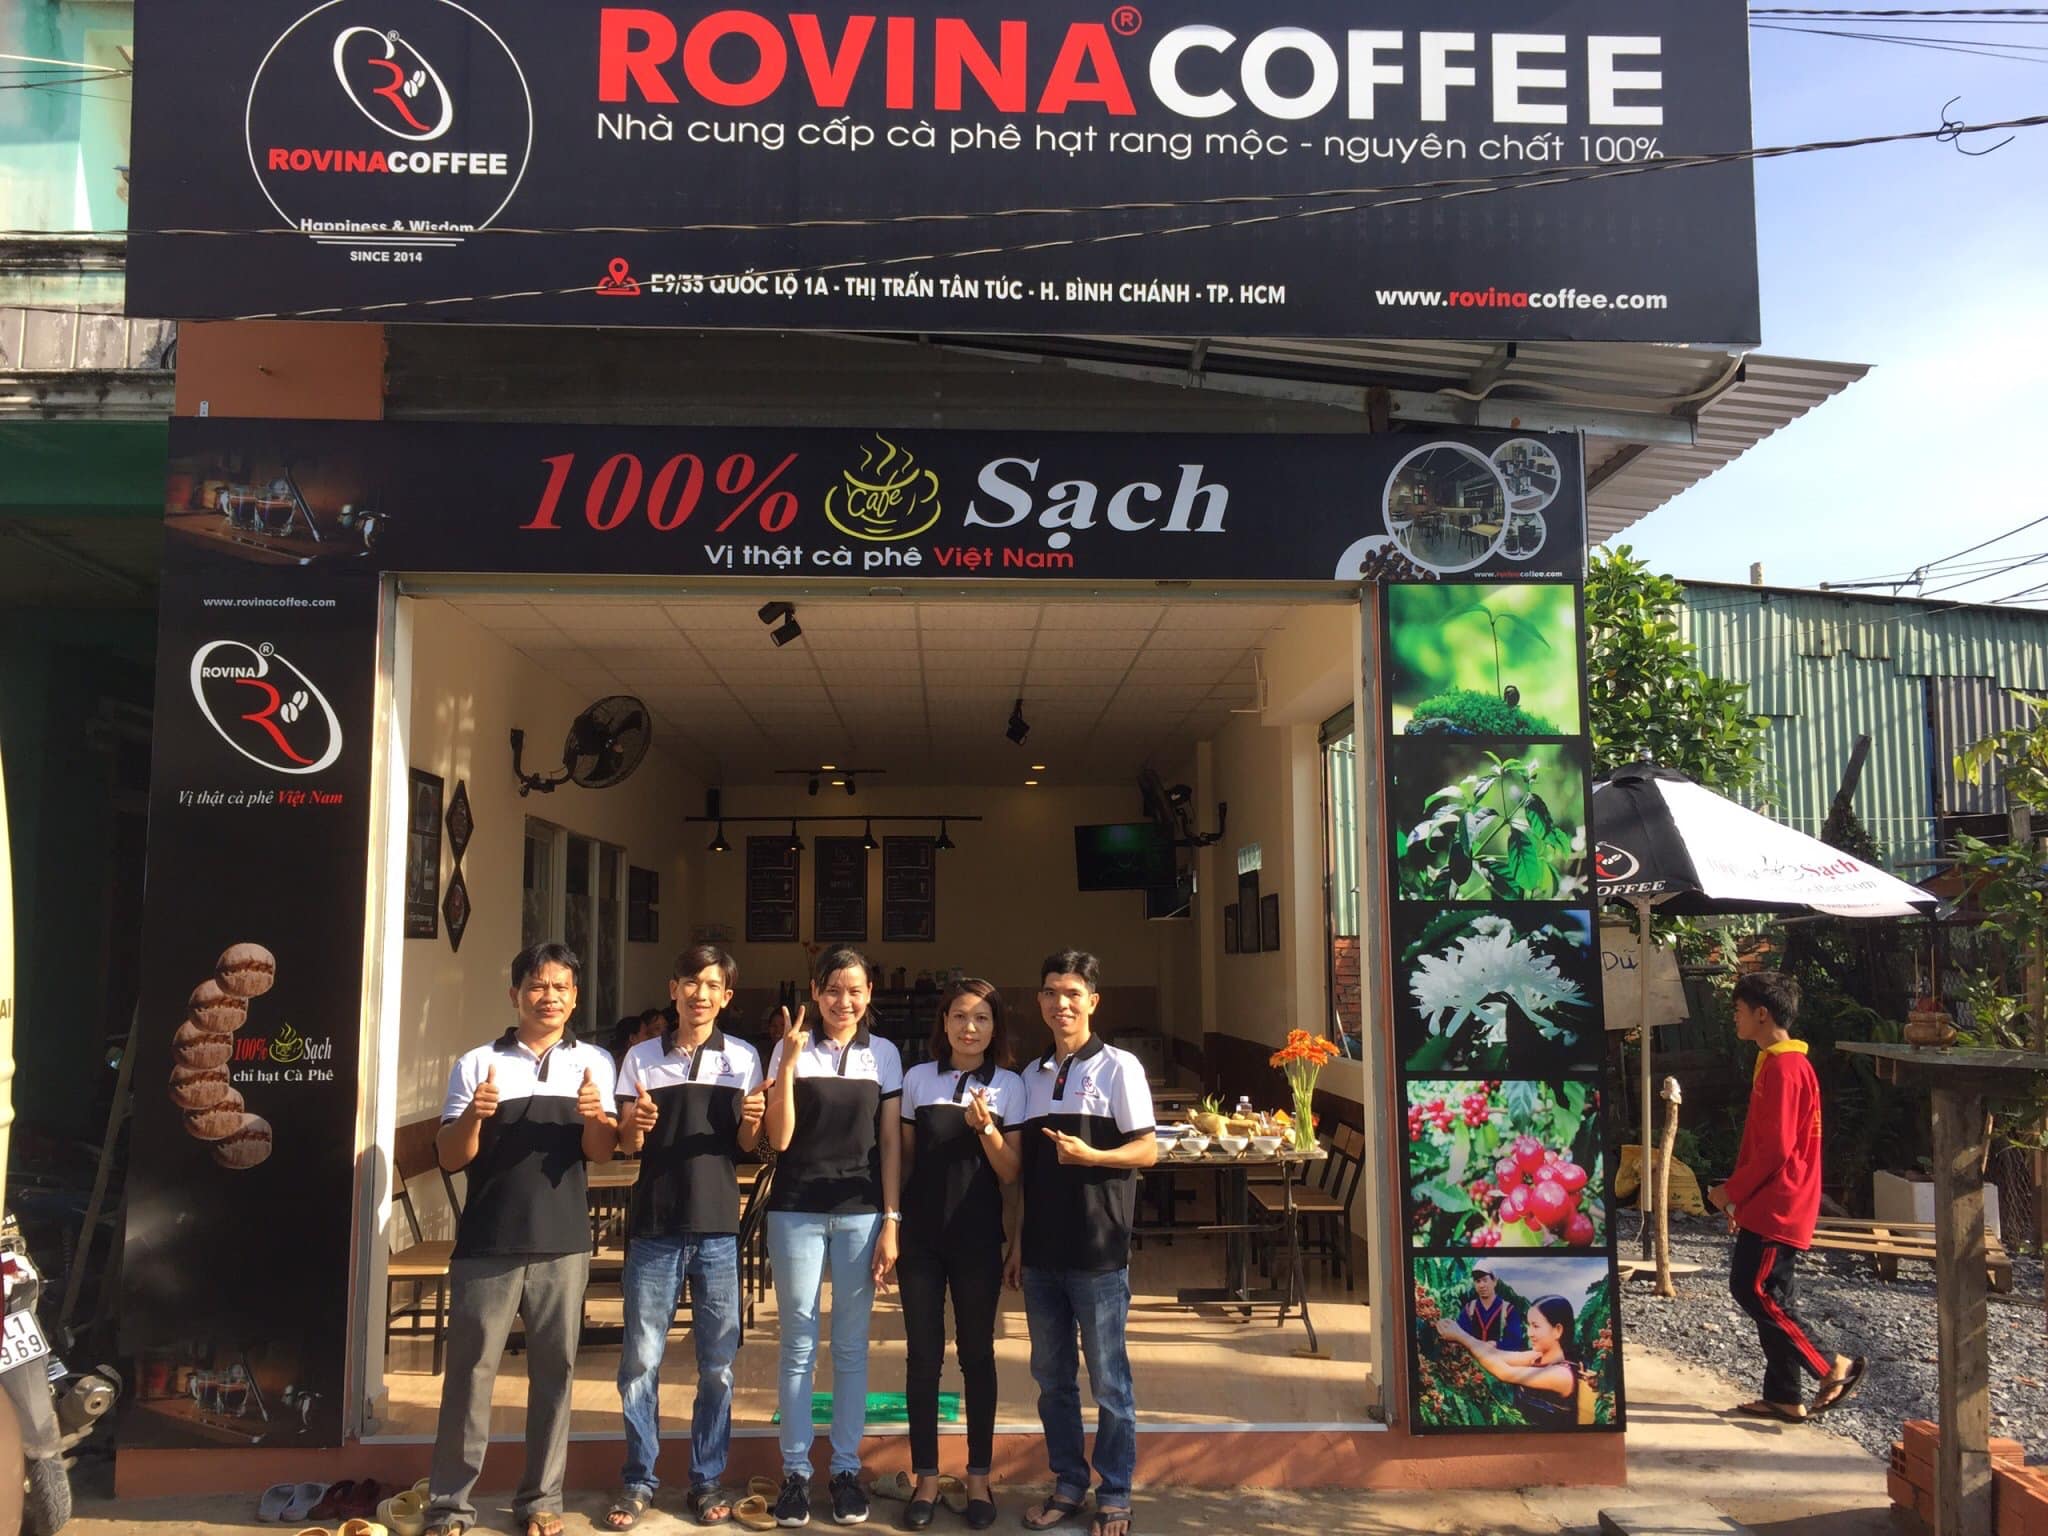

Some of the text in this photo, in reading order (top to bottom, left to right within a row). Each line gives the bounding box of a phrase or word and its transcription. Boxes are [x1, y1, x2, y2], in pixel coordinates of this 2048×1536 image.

[1149, 24, 1664, 126] COFFEE
[596, 112, 673, 142] Nhà
[687, 121, 785, 149] cung
[797, 117, 875, 151] cấp
[886, 121, 936, 148] cà
[950, 123, 1021, 153] phê
[1035, 124, 1095, 157] hạt
[1109, 130, 1193, 160] rang
[1205, 127, 1288, 160] mộc
[1324, 131, 1467, 165] nguyên
[1478, 132, 1565, 162] chất
[1580, 135, 1665, 163] 100%
[268, 148, 508, 175] ROVINACOFFEE
[300, 218, 475, 233] Happiness & Wisdom
[350, 251, 424, 263] SINCE 2014
[710, 268, 769, 296] QUỐC
[775, 272, 799, 300] LỘ
[804, 277, 829, 297] 1A
[845, 276, 877, 302] THỊ
[884, 271, 935, 298] TRẤN
[940, 274, 979, 299] TÂN
[984, 275, 1023, 300] TÚC
[1040, 281, 1060, 301] H.
[1066, 277, 1113, 302] BÌNH
[1119, 278, 1190, 303] CHÁNH
[1206, 283, 1235, 304] TP.
[1239, 285, 1286, 305] HCM
[1375, 286, 1669, 311] www.rovinacoffee.com
[519, 452, 800, 533] 100%
[963, 457, 1230, 550] Sạch
[704, 544, 1075, 571] Vị thật cà phê Việt Nam
[203, 597, 337, 608] www.rovinacoffee.com
[202, 667, 256, 678] ROVINA
[177, 790, 343, 807] Vị thật cà phê Việt Nam
[1597, 880, 1666, 896] OFFEE
[234, 1038, 268, 1061] 100%
[303, 1037, 332, 1064] Sạch
[257, 1070, 280, 1084] hạt
[284, 1069, 303, 1081] Cà
[308, 1069, 334, 1081] Phê
